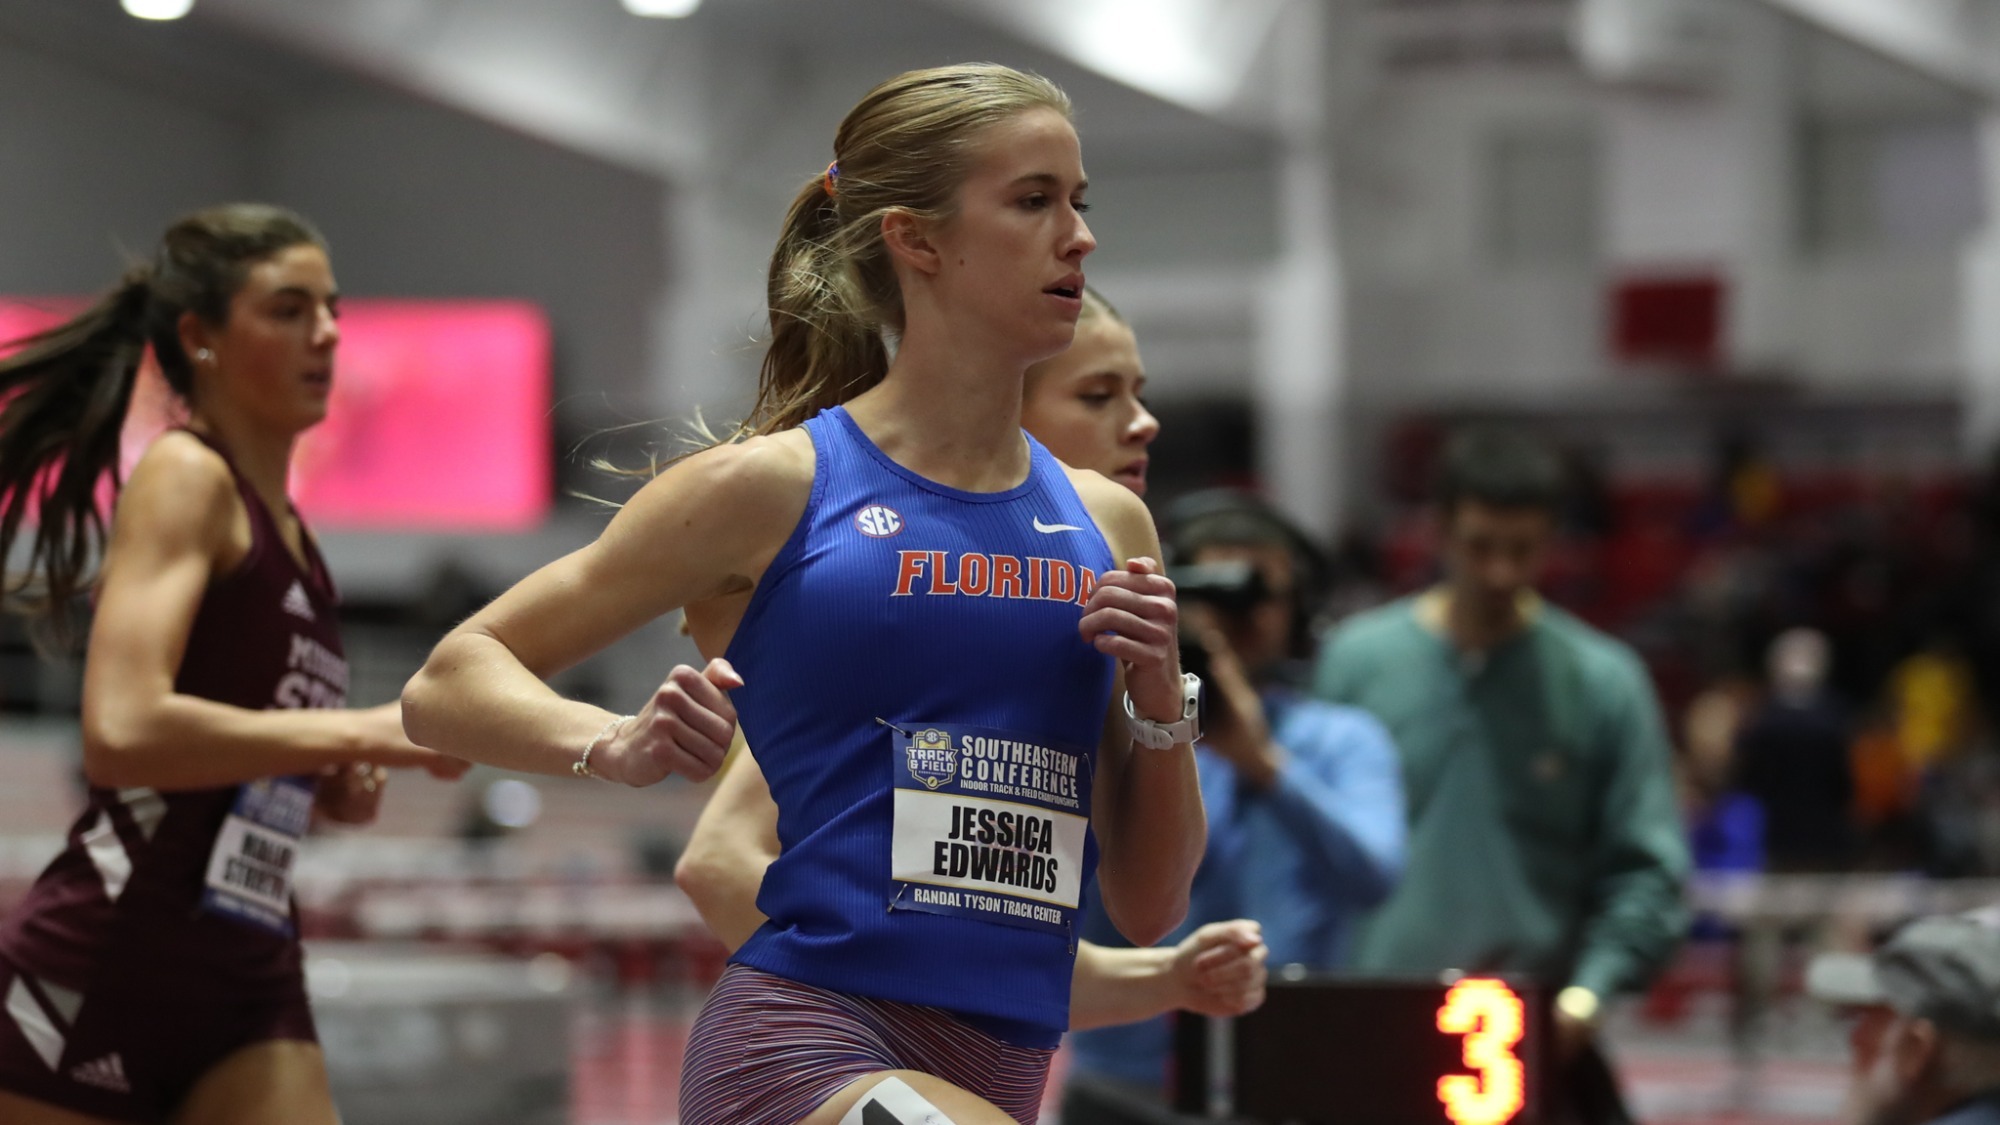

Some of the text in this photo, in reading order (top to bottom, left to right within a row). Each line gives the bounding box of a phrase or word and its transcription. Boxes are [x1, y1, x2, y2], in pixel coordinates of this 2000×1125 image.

[858, 506, 900, 535] SEC
[909, 748, 954, 762] TRACK
[910, 759, 918, 770] &
[921, 760, 954, 773] FIELD
[961, 735, 1078, 777] SOUTHEASTERN
[960, 779, 1079, 809] INDOOR TRACK & FIELD CHAMPIONSHIPS
[961, 757, 1078, 799] CONFERENCE
[948, 805, 1053, 855] JESSICA
[933, 841, 1058, 894] EDWARDS
[914, 888, 1061, 925] RANDAL TYSON TRACK CENTER
[1436, 978, 1524, 1125] 3
